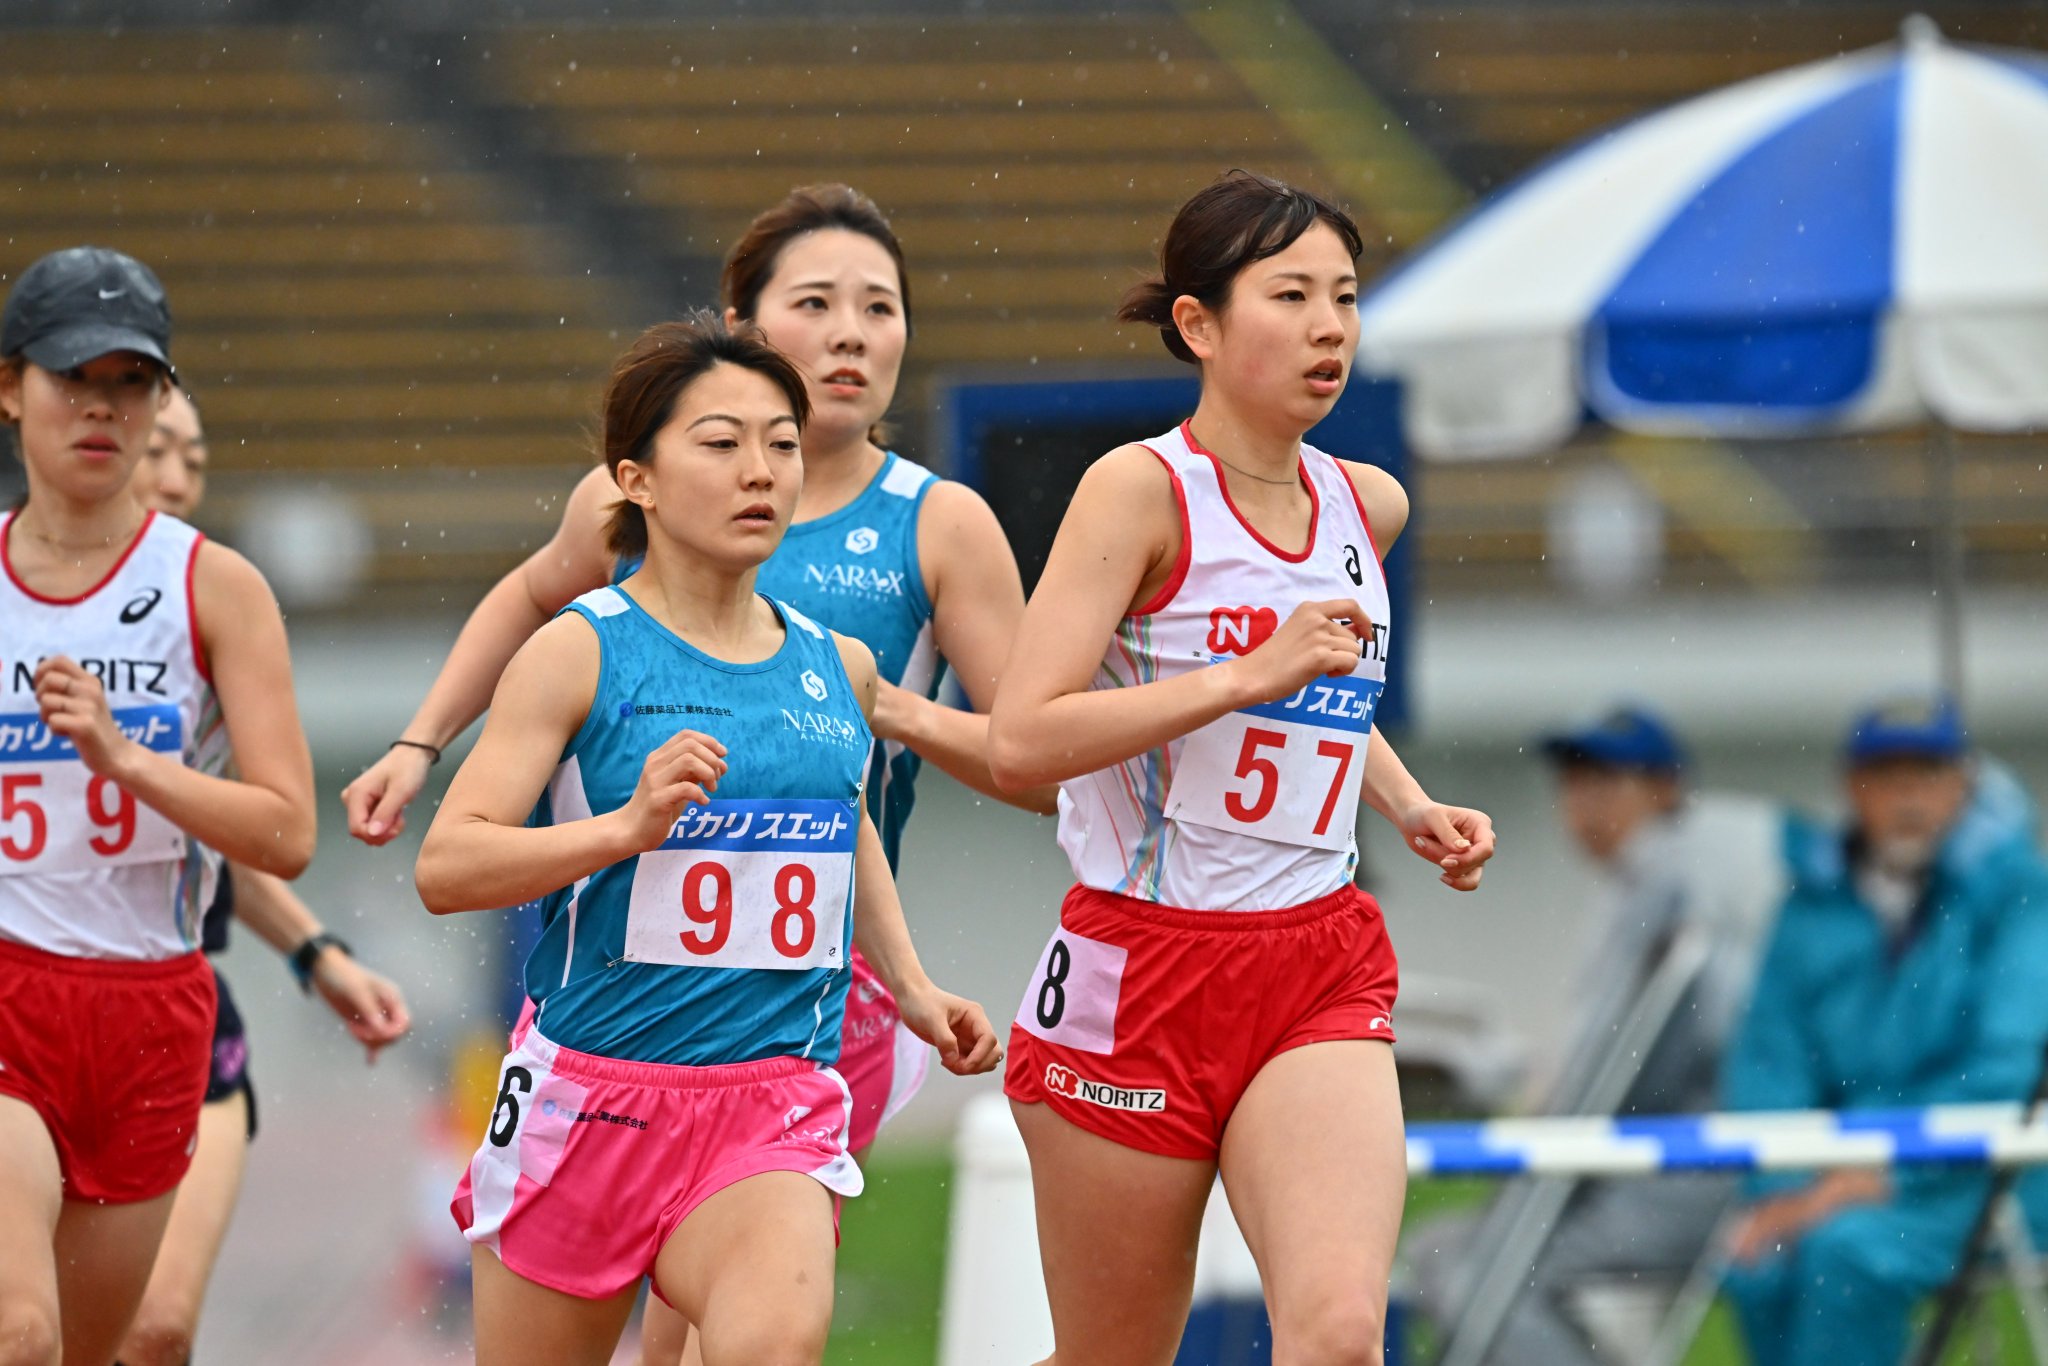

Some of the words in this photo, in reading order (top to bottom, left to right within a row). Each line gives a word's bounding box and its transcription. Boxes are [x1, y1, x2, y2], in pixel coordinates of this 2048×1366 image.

[12, 655, 168, 697] NRITZ
[0, 773, 137, 863] 59
[1224, 726, 1354, 836] 57
[679, 860, 817, 959] 98
[1035, 938, 1071, 1029] 8
[489, 1065, 533, 1148] 6
[1081, 1081, 1164, 1110] NORITZ
